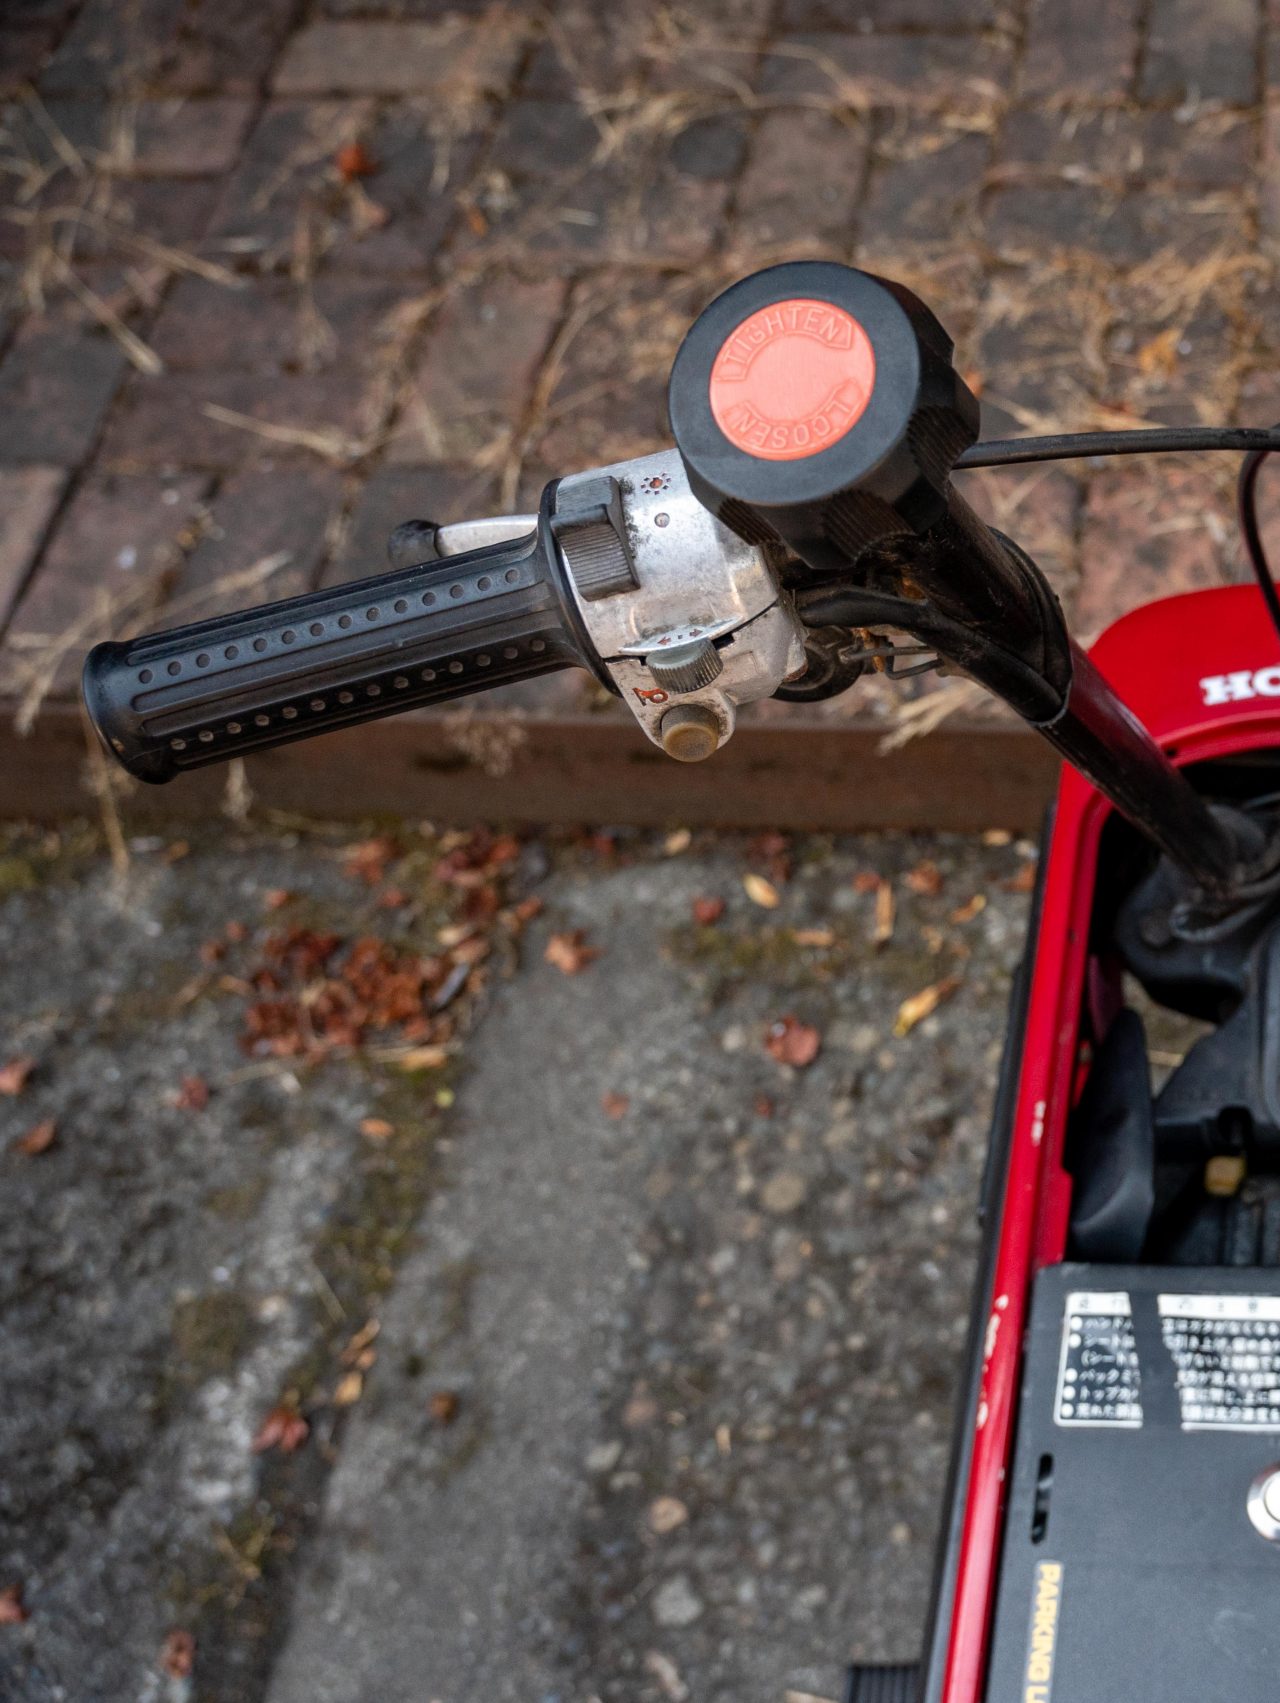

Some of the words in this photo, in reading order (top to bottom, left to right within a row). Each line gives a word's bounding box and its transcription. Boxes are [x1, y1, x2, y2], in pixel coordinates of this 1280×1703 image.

[723, 306, 838, 365] TIGHTEN
[730, 399, 851, 449] LOOSEN
[1028, 1564, 1060, 1681] PARKING
